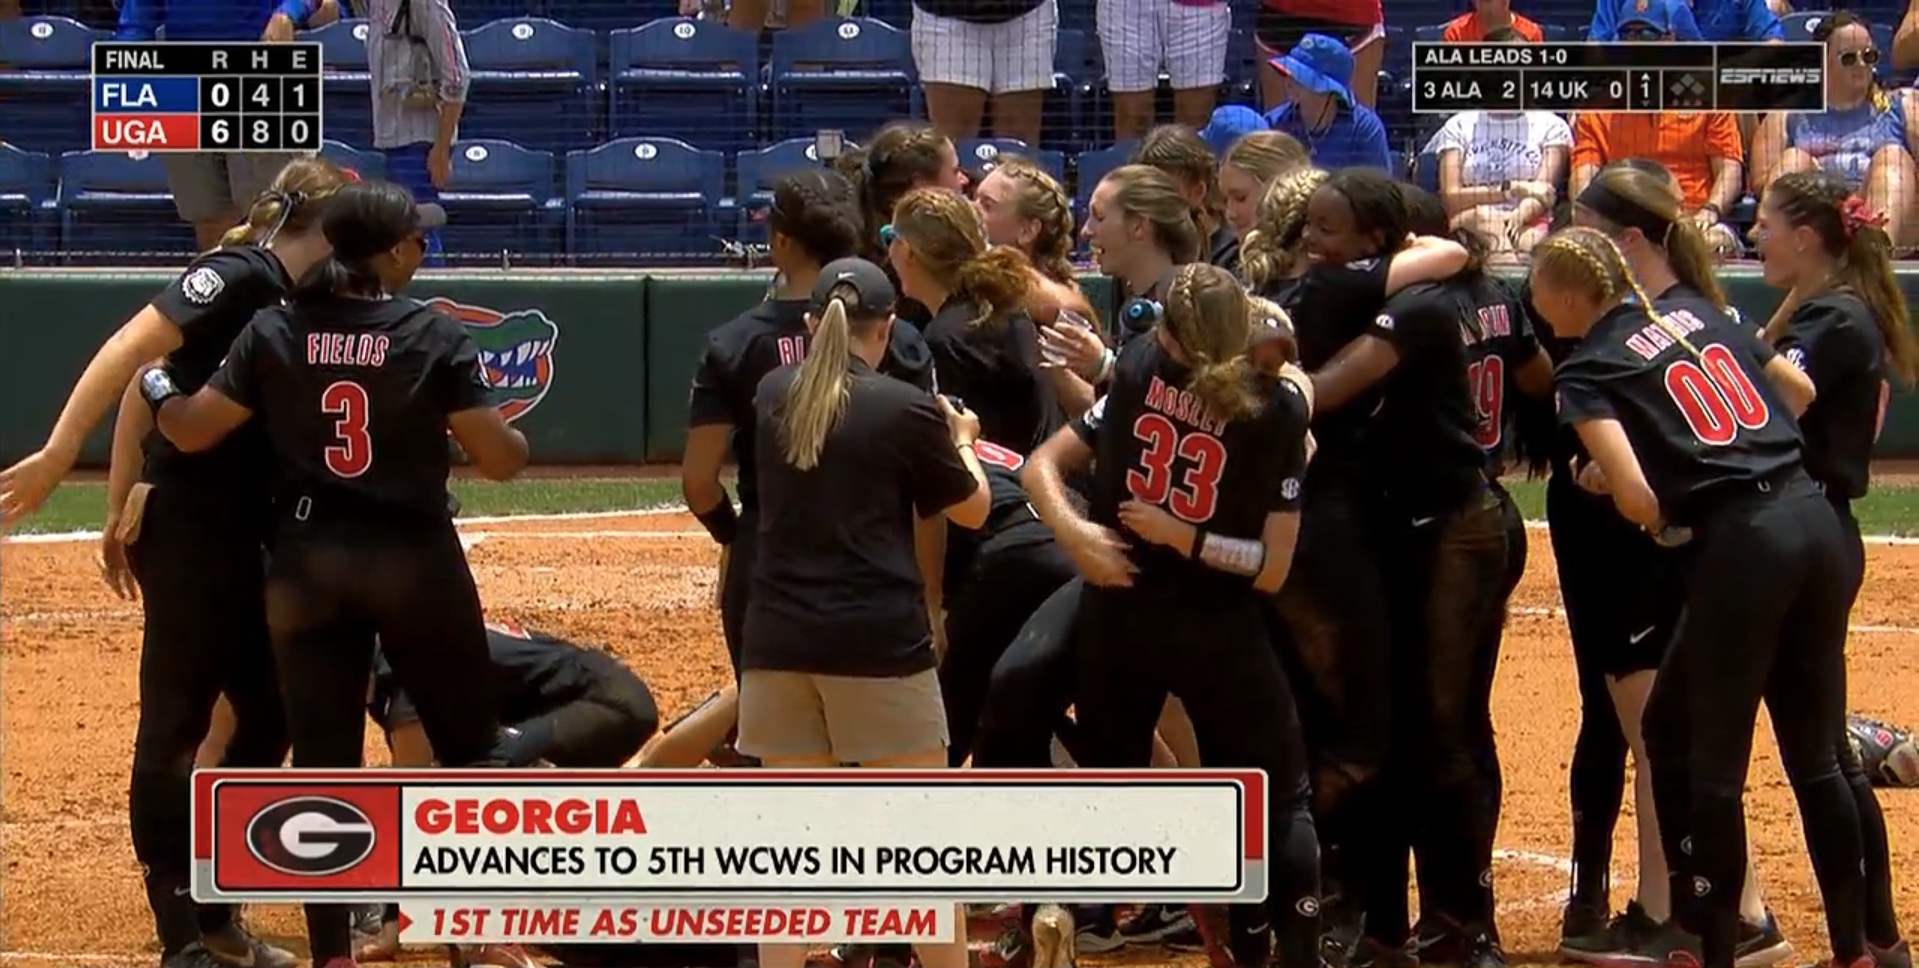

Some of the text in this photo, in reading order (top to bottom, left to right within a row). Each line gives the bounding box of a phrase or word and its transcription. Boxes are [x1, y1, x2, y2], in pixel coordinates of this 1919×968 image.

[307, 333, 390, 367] FIELDS
[1664, 343, 1769, 446] 00
[322, 380, 373, 479] 3
[1126, 412, 1228, 524] 33
